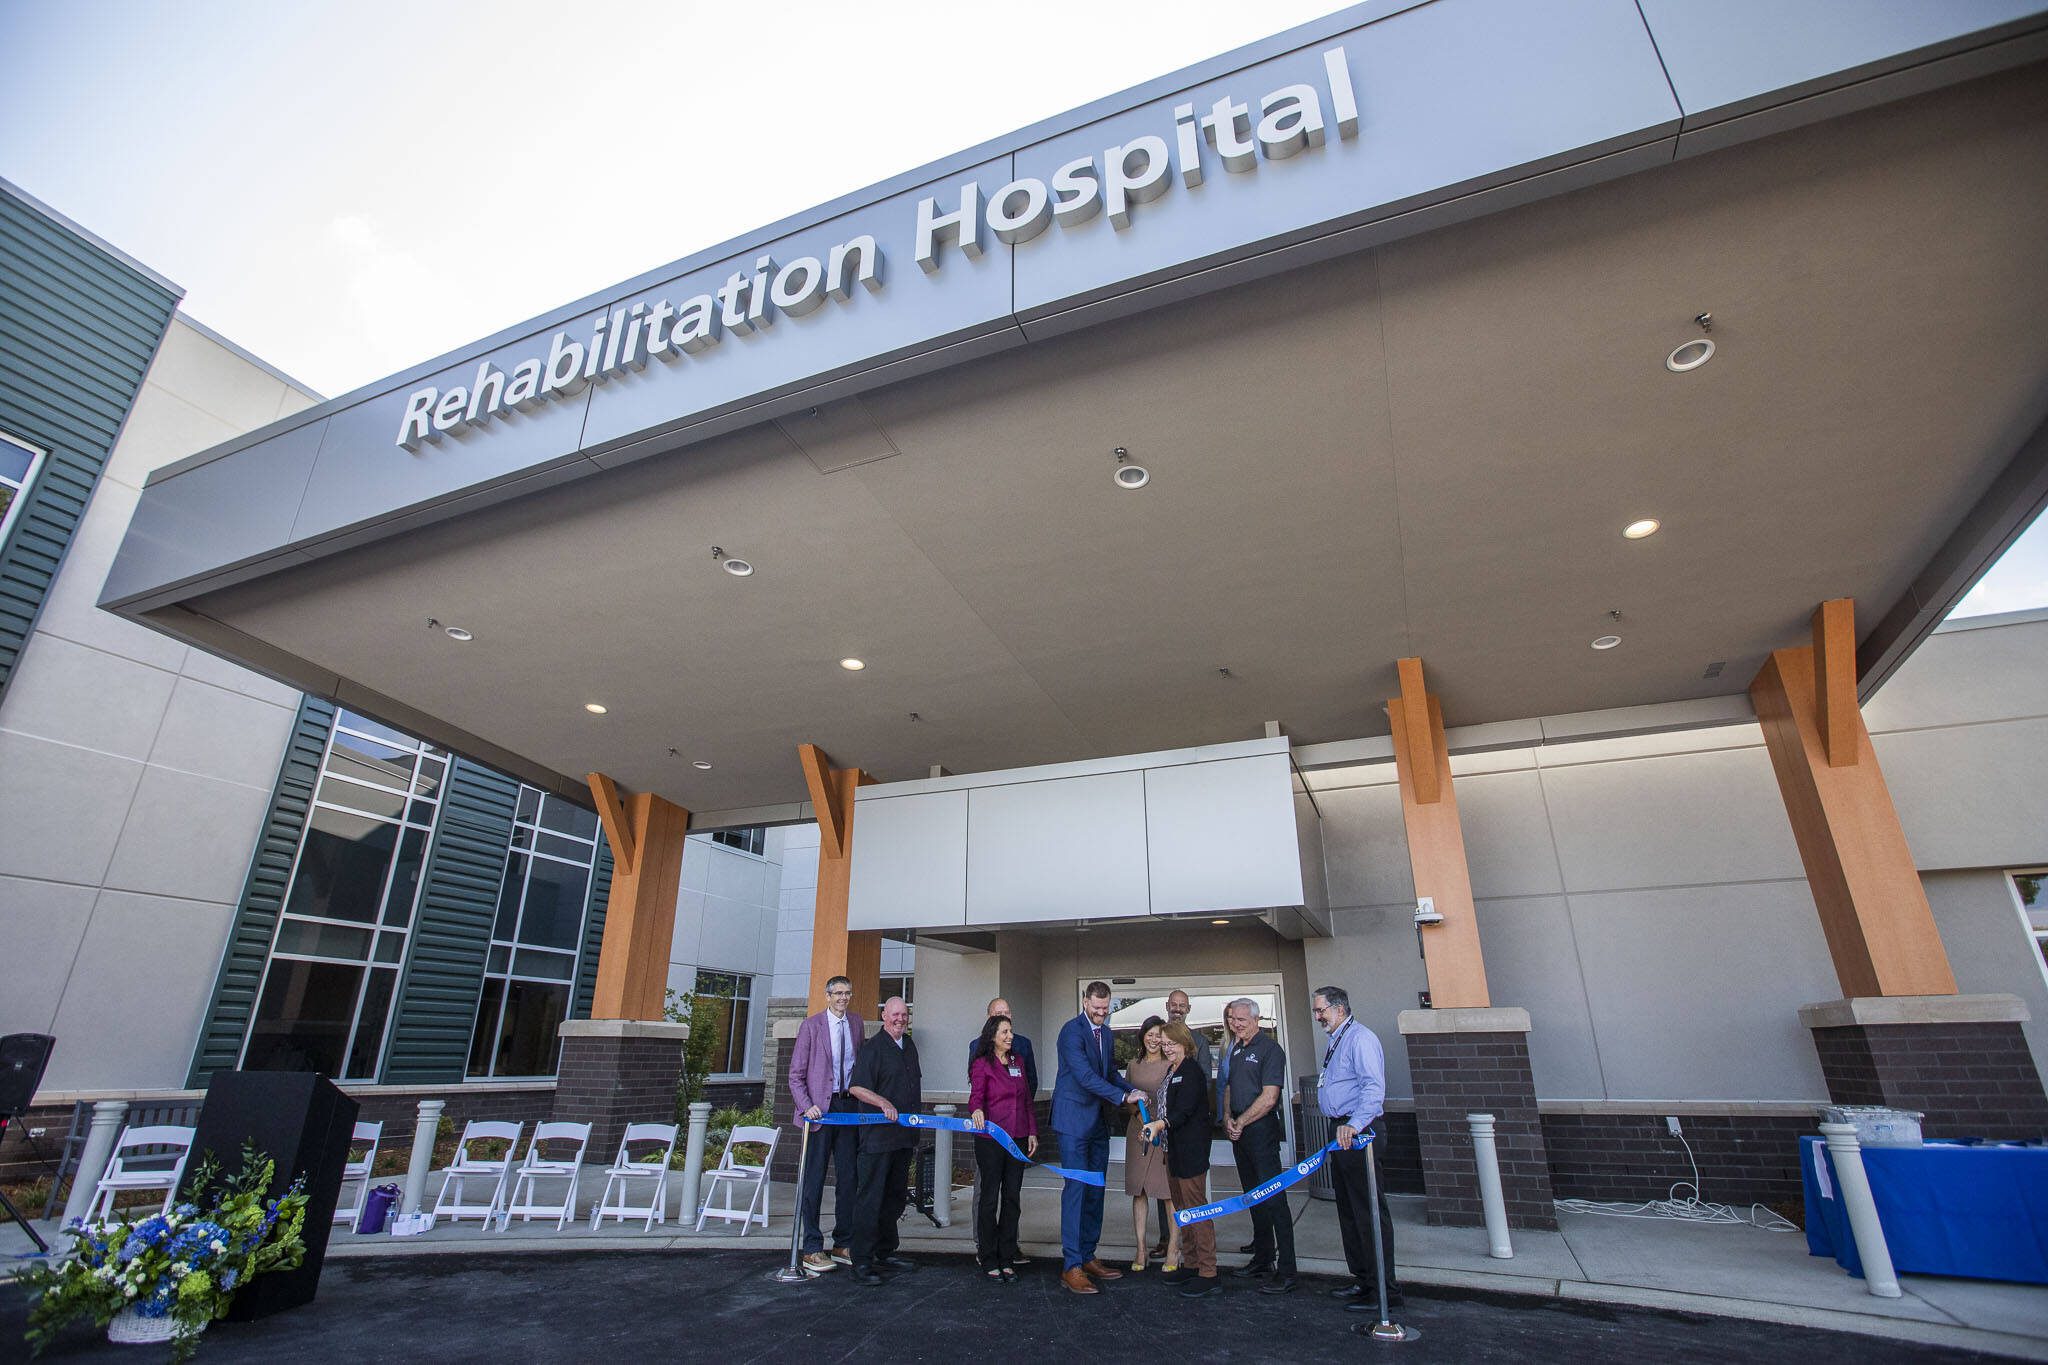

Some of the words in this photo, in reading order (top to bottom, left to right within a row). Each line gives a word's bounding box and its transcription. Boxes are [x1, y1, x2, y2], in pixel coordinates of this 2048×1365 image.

[396, 235, 881, 450] Rehabilitation
[915, 46, 1358, 267] Hospital
[1253, 1181, 1282, 1200] MUKILTEO
[1191, 1206, 1223, 1219] MUKILTEO
